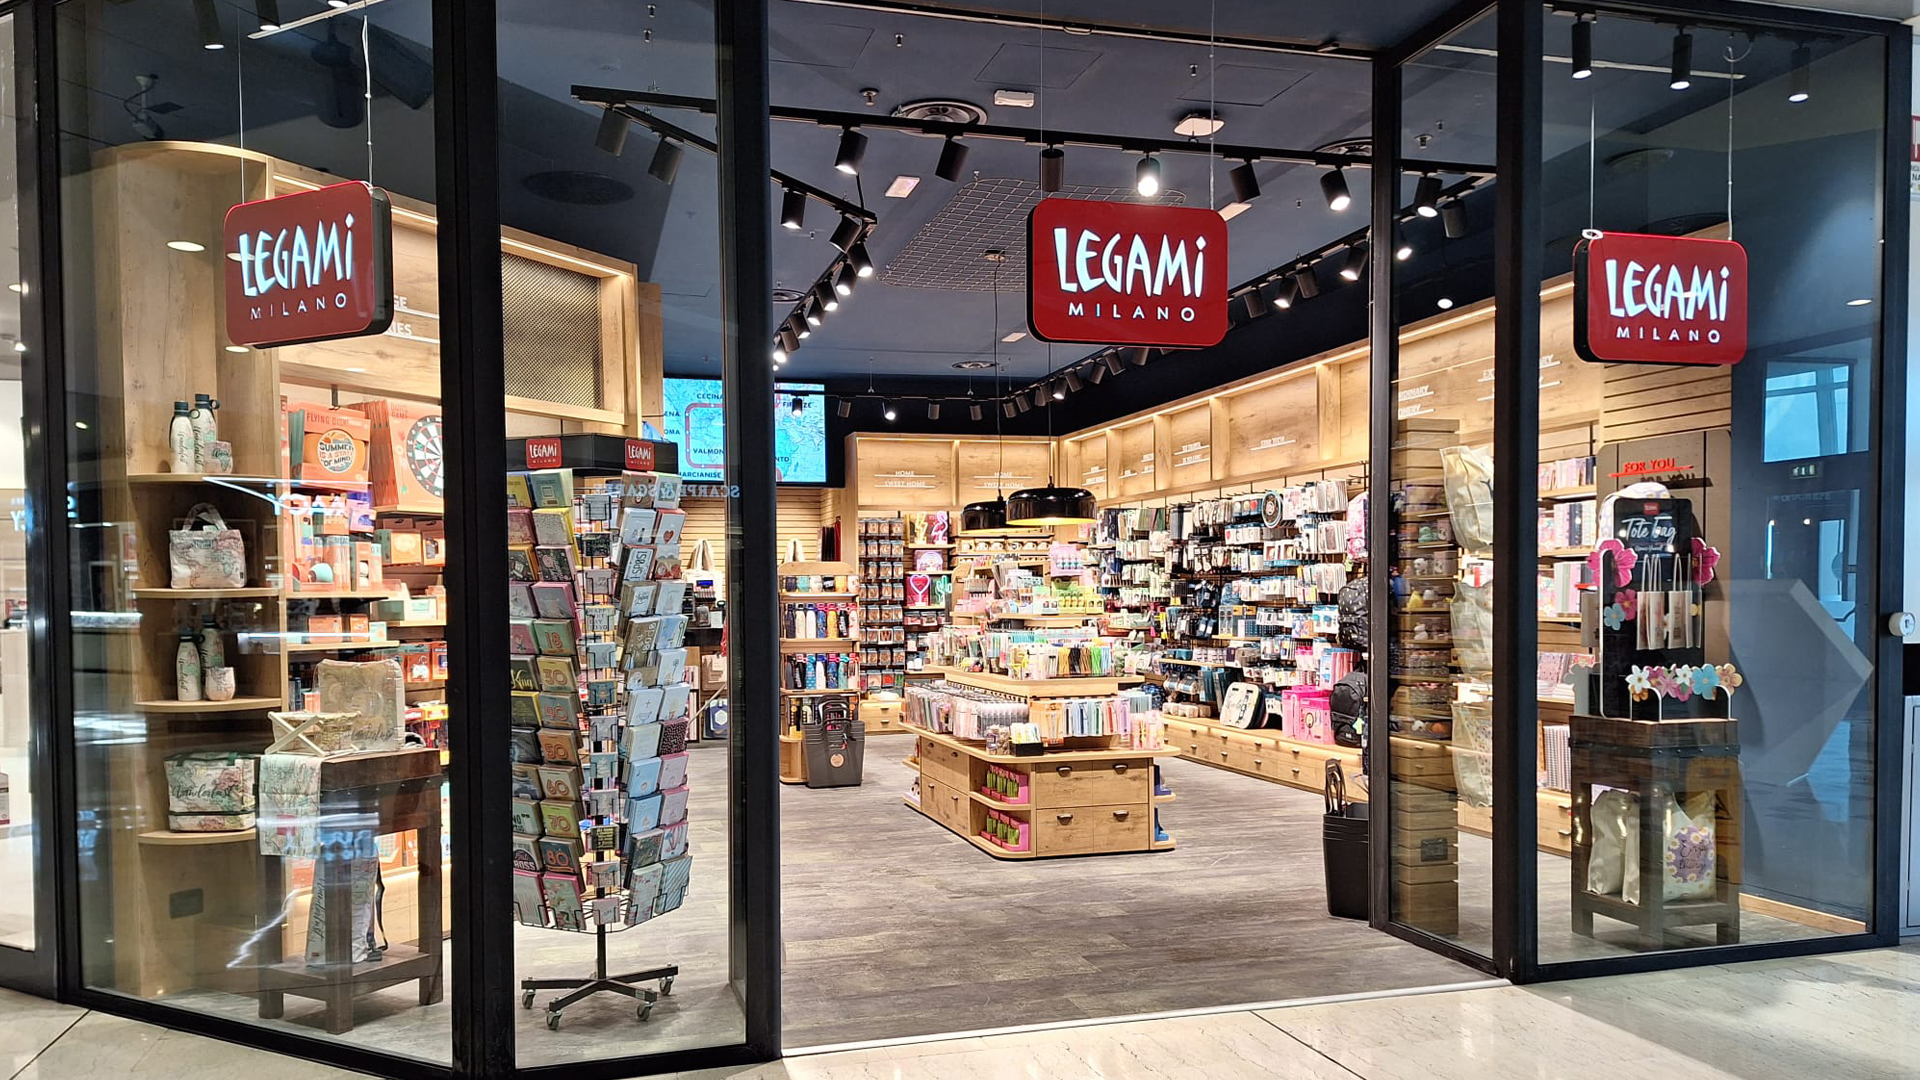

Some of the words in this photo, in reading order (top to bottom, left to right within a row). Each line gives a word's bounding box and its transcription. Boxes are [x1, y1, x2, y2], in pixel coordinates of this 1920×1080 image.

[250, 292, 347, 320] MILANO
[1068, 302, 1196, 322] MILANO
[1616, 326, 1721, 343] MILANO
[306, 412, 330, 424] FLYING
[1623, 461, 1647, 473] FOR
[1650, 457, 1676, 470] YOU
[1621, 517, 1652, 540] Tote
[545, 631, 563, 649] 18
[542, 668, 567, 686] 30
[545, 705, 569, 721] 40
[544, 742, 569, 760] 50
[546, 778, 570, 796] 60
[547, 814, 571, 832] 70
[547, 851, 570, 866] 80
